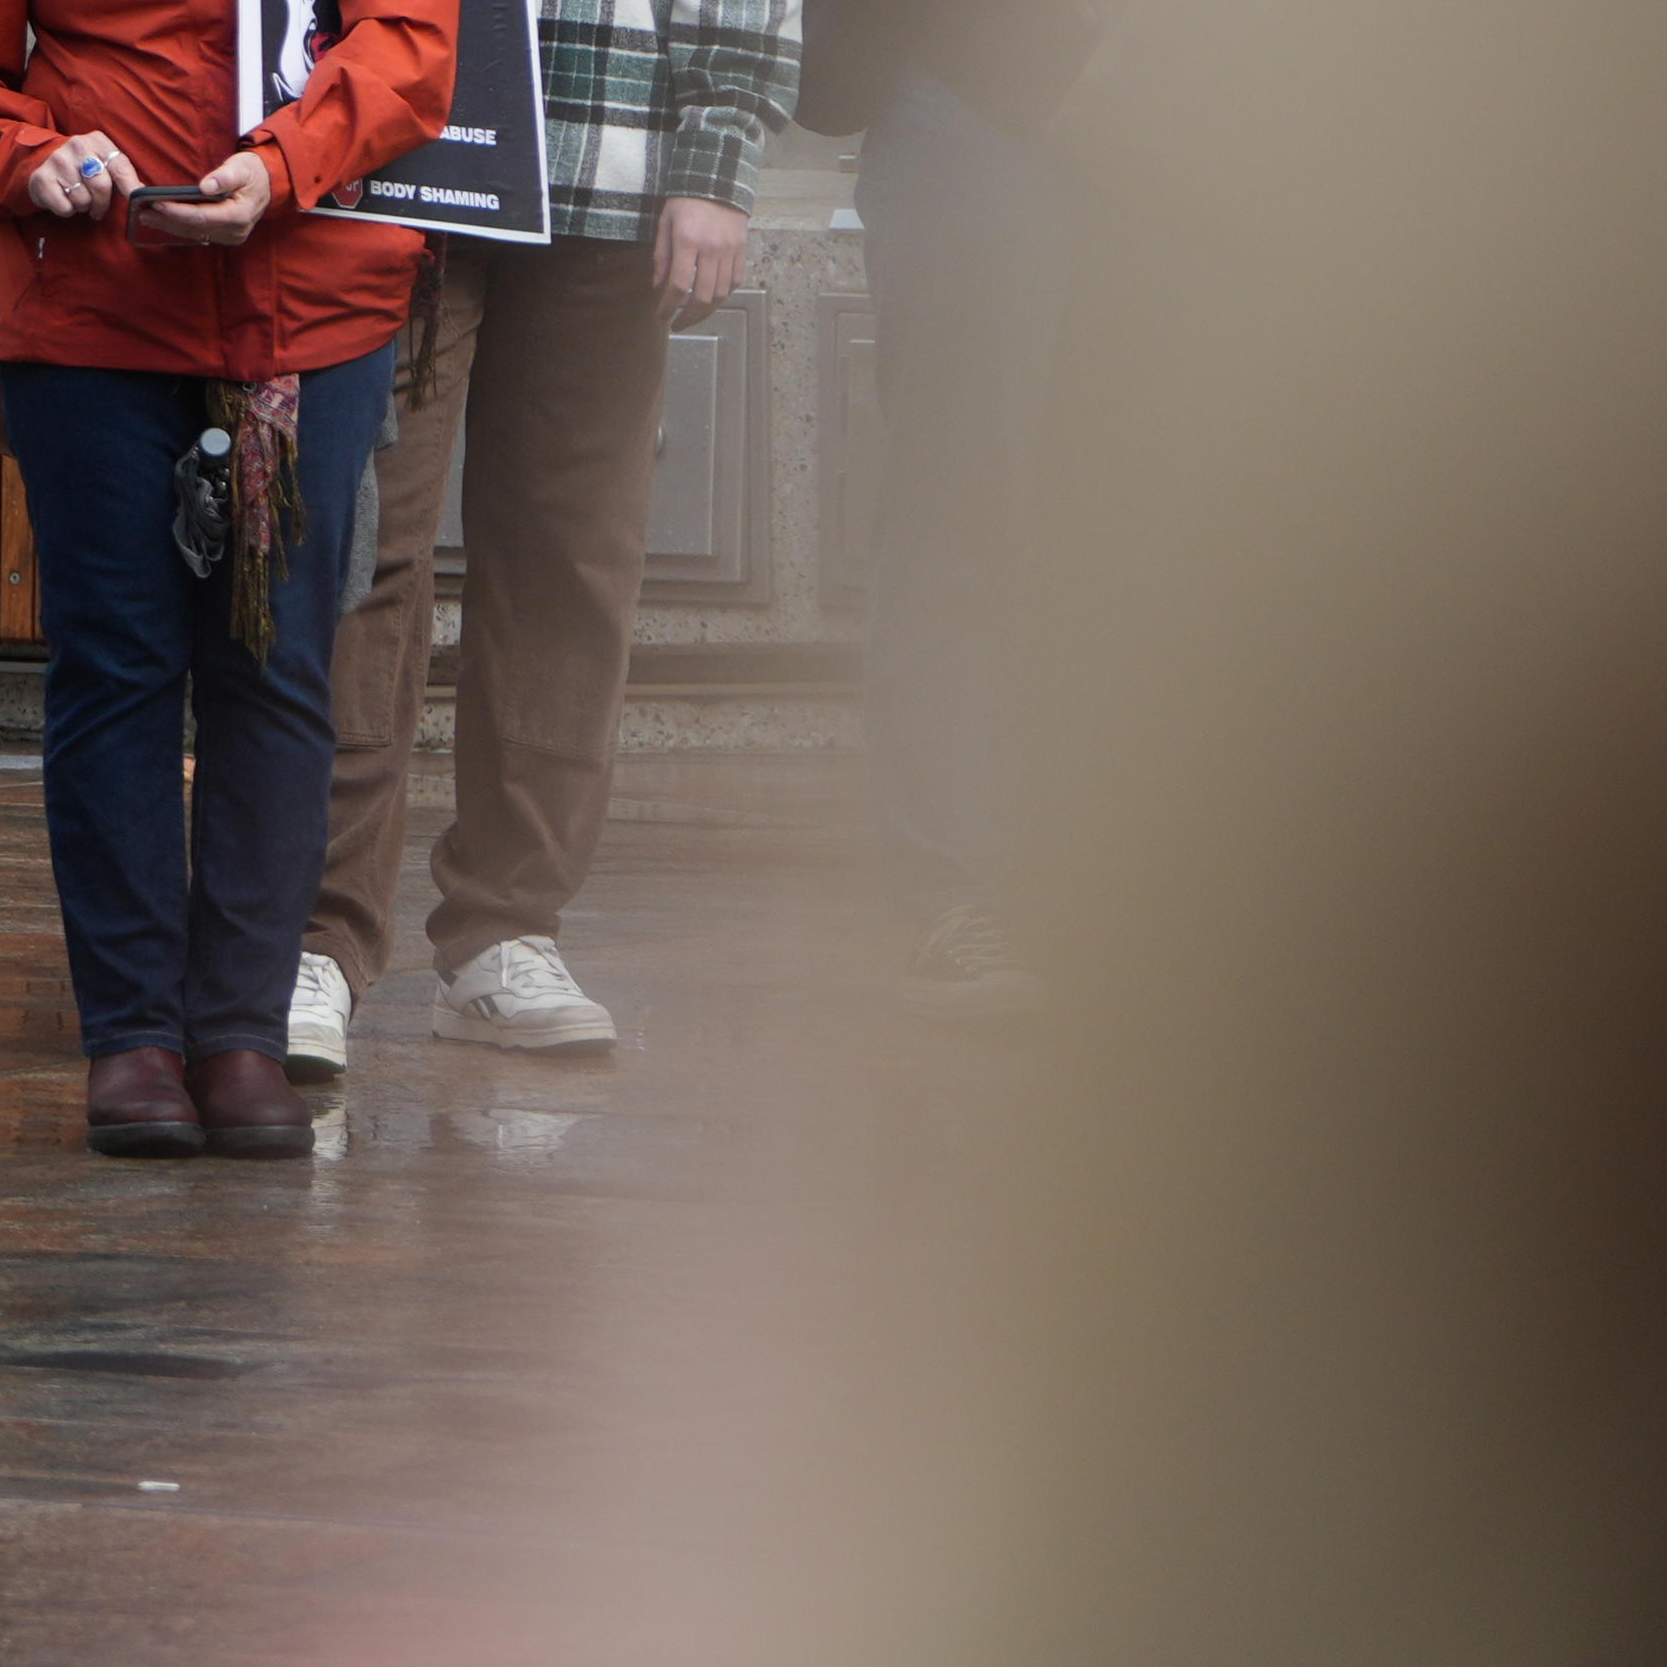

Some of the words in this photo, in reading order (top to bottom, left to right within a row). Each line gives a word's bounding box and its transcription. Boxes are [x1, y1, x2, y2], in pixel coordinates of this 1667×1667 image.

[440, 125, 497, 145] ABUSE
[370, 179, 416, 200] BODY
[419, 185, 500, 210] SHAMING
